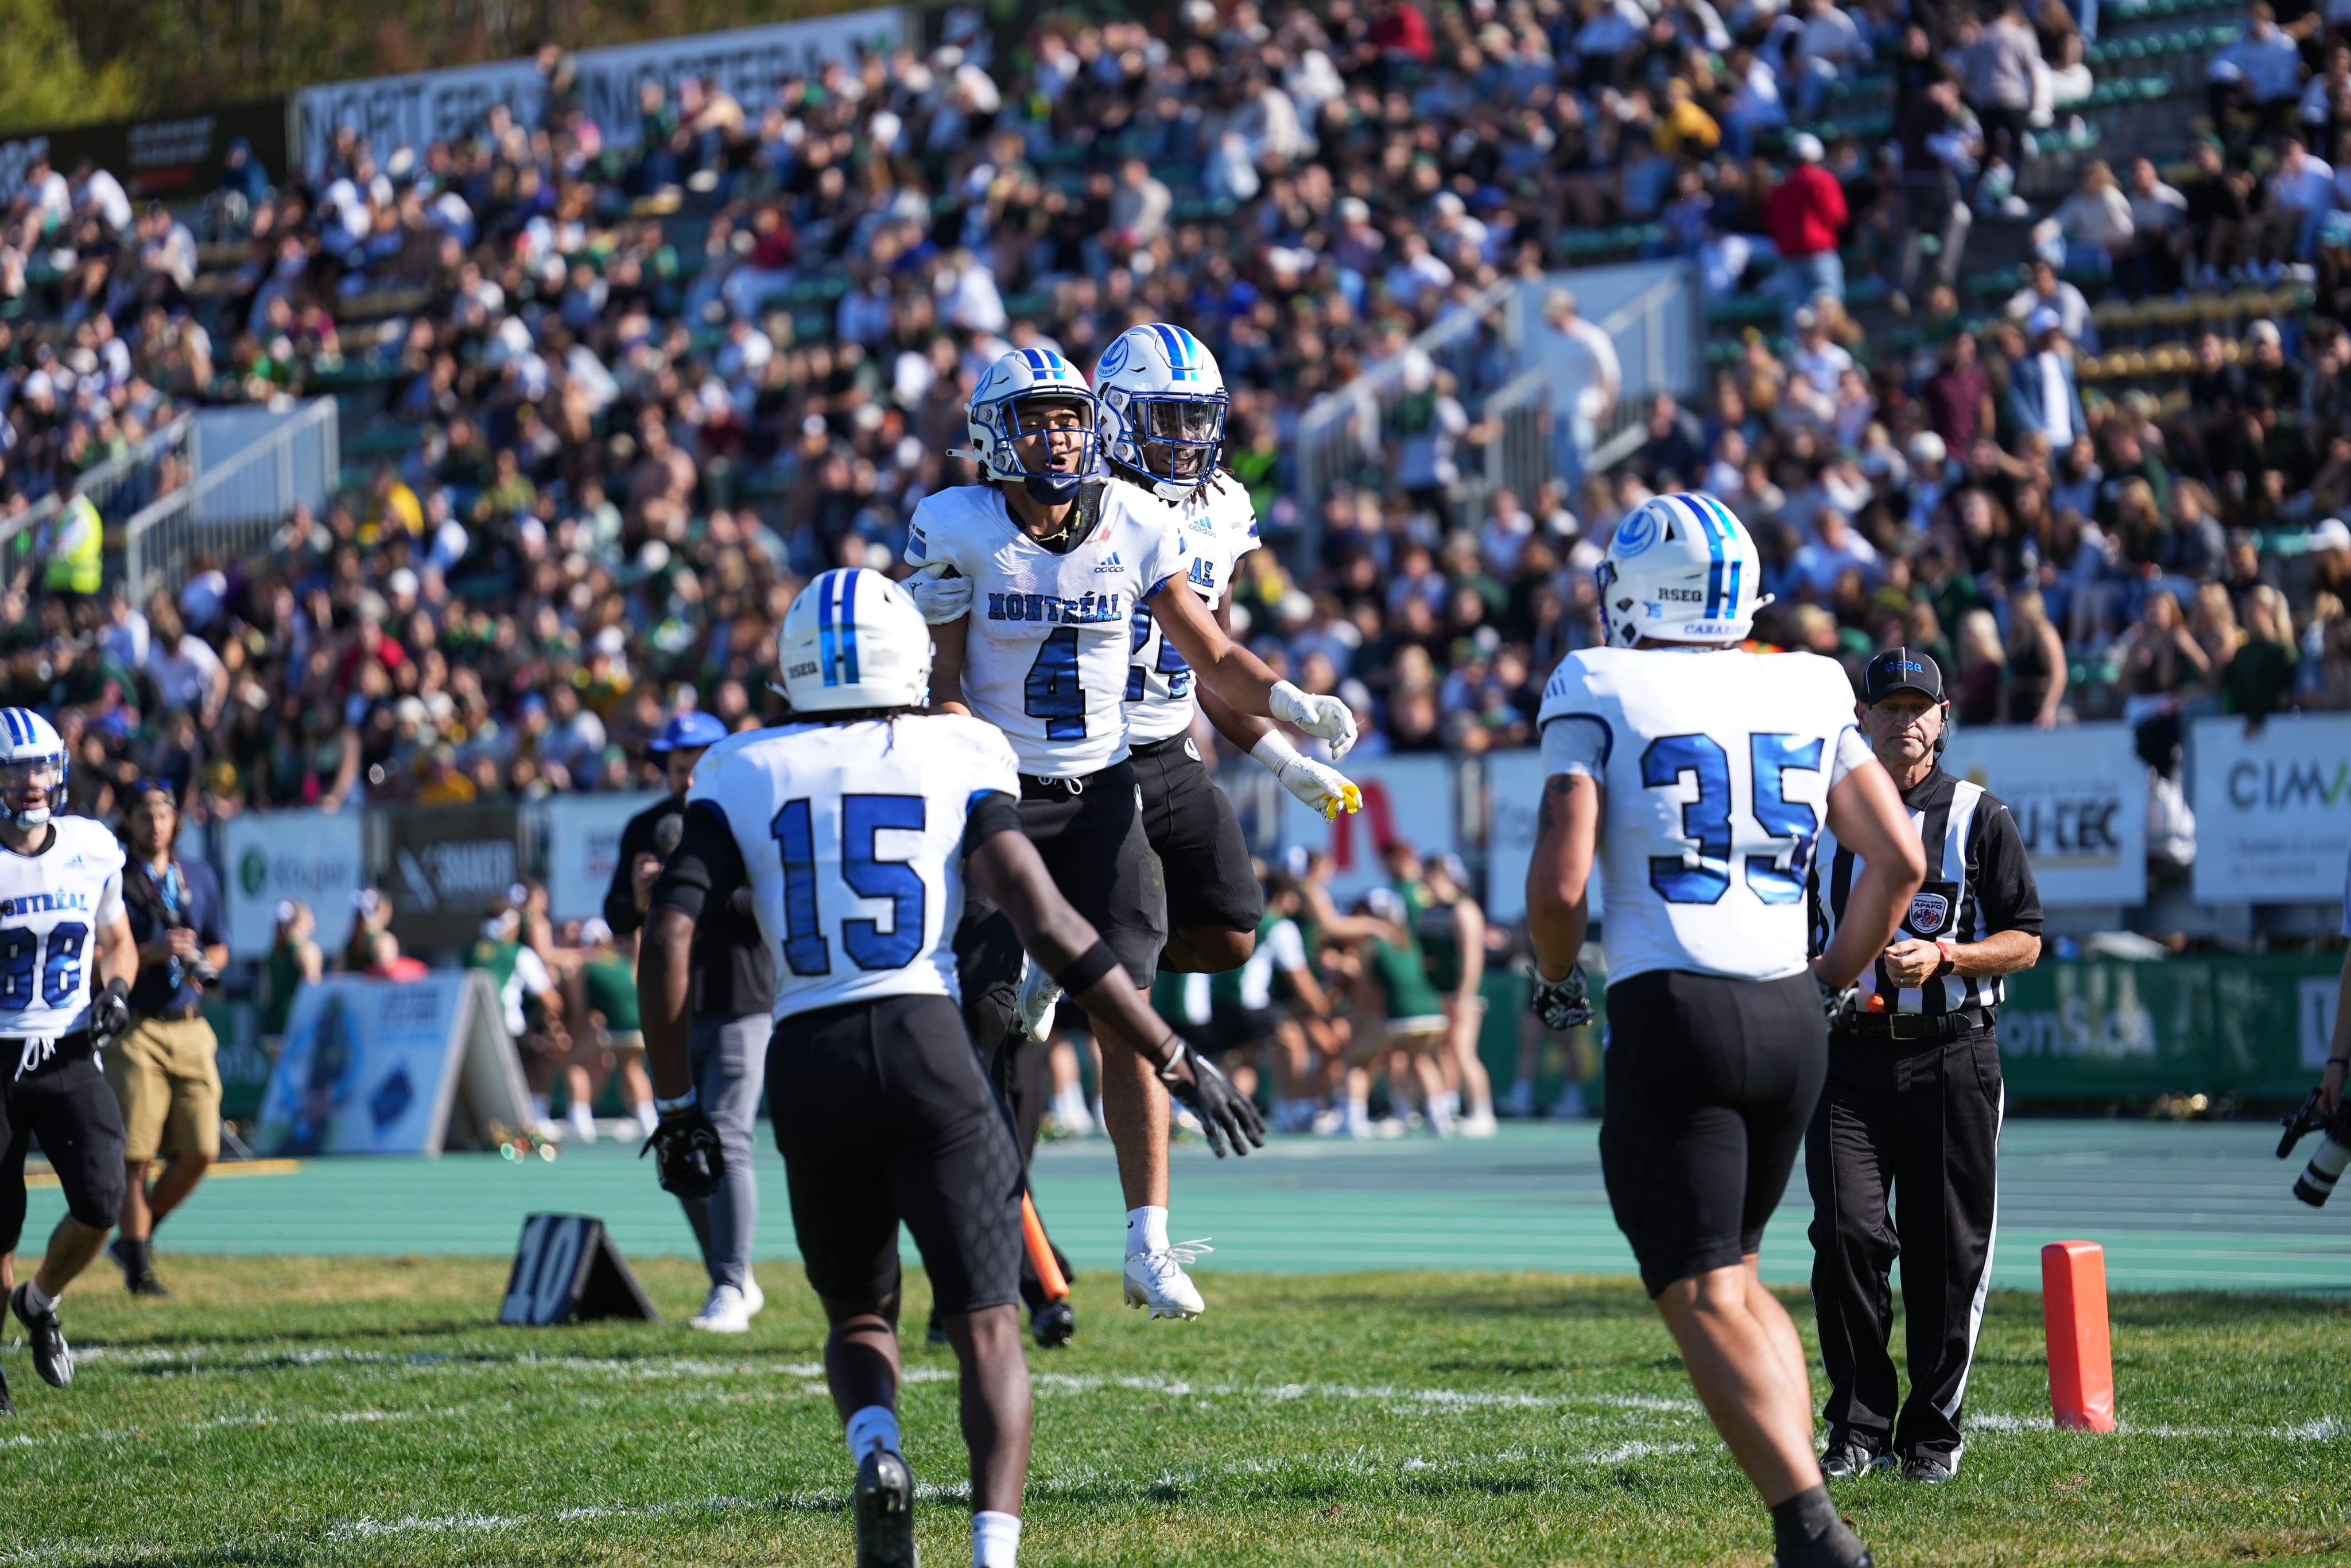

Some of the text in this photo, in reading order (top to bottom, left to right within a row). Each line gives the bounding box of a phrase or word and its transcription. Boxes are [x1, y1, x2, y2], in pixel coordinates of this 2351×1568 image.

[1189, 523, 1216, 538] adidas
[1095, 565, 1124, 573] adidas
[1658, 587, 1702, 601] RSEQ
[988, 591, 1122, 624] MONTRÉAL
[1023, 626, 1087, 740] 4
[1885, 661, 1923, 673] RSEQ
[1640, 732, 1825, 905] 35
[770, 793, 926, 976] 15
[0, 921, 89, 1010] 88
[501, 1214, 581, 1324] 10
